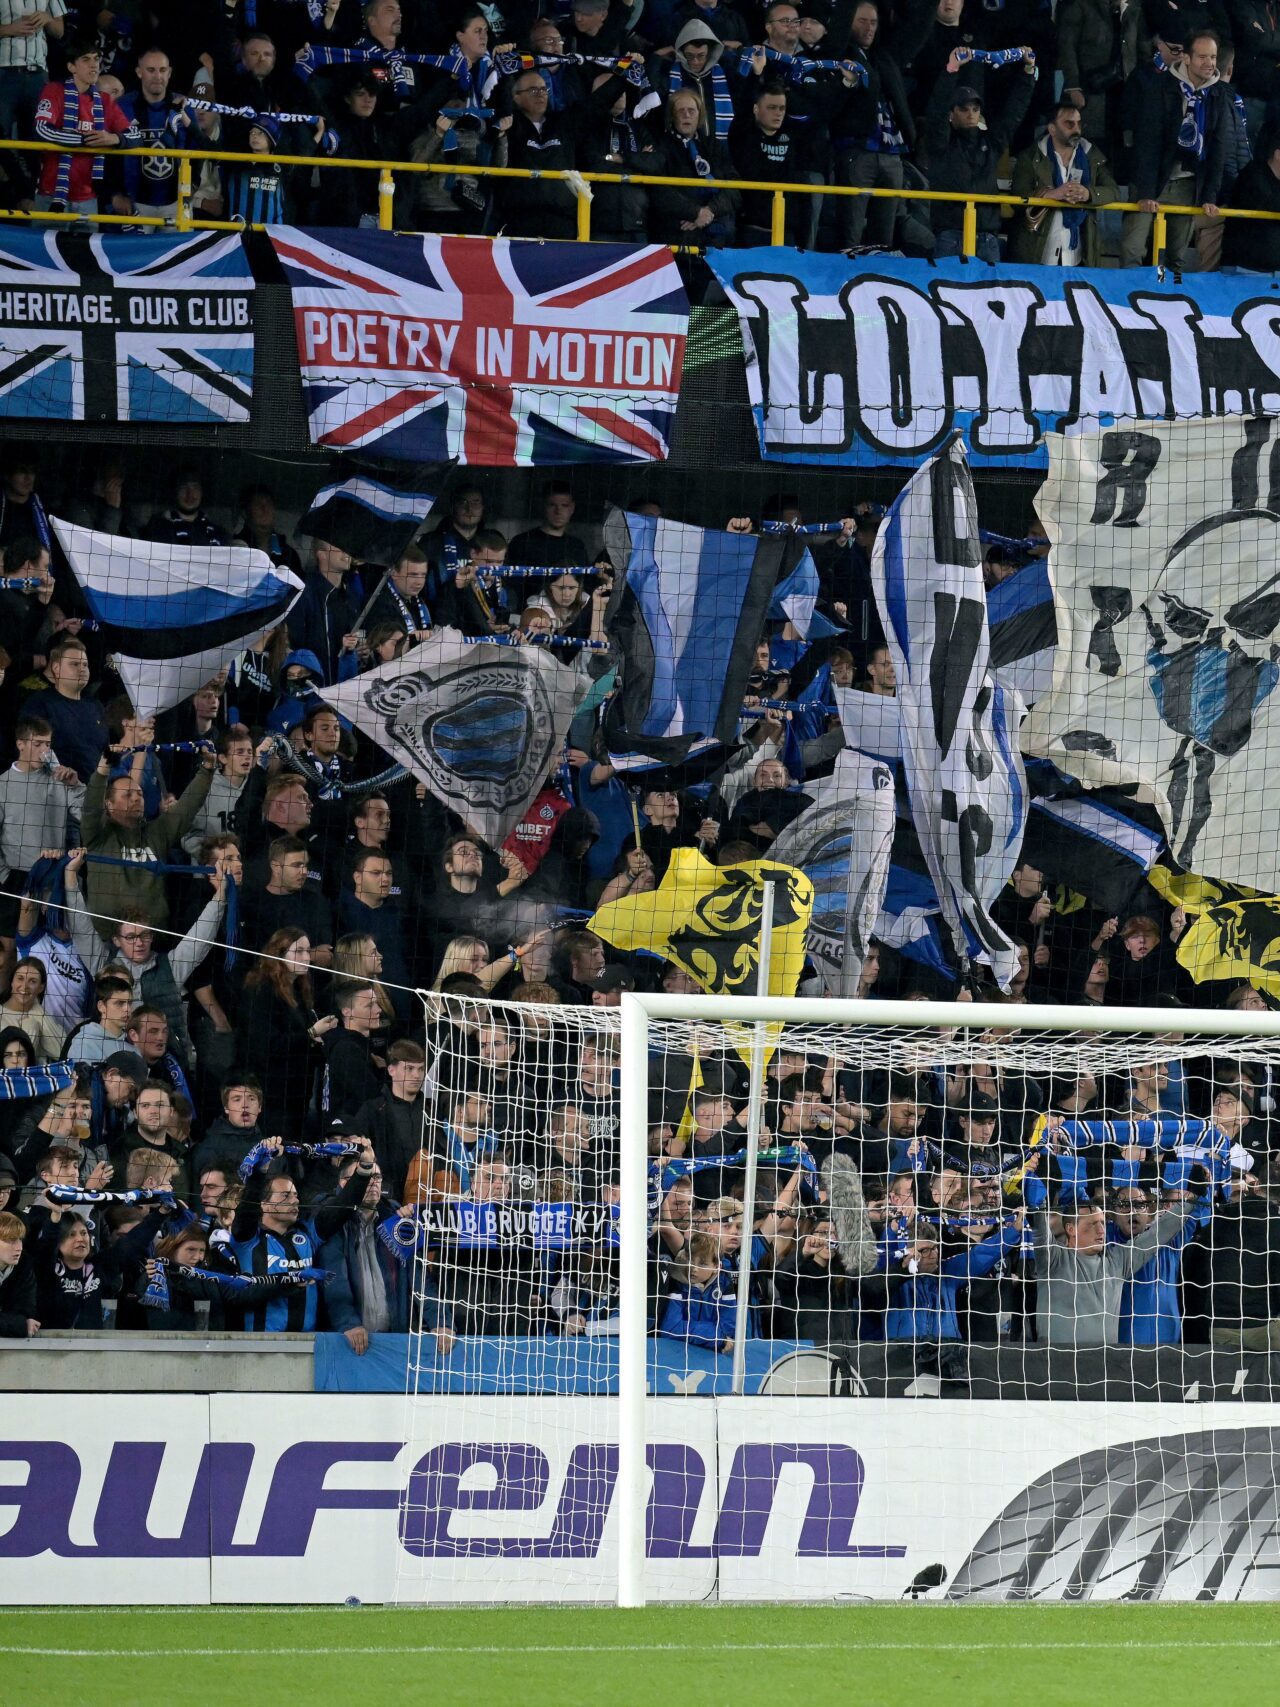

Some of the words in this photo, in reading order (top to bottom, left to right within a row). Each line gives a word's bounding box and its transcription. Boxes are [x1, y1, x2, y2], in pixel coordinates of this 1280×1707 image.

[129, 296, 179, 326] OUR
[304, 311, 460, 371] POETRY
[475, 326, 513, 377] IN
[526, 331, 678, 387] MOTION
[516, 823, 552, 836] NIBET
[422, 1209, 480, 1234] CLUB
[486, 1209, 568, 1234] BRUGGE
